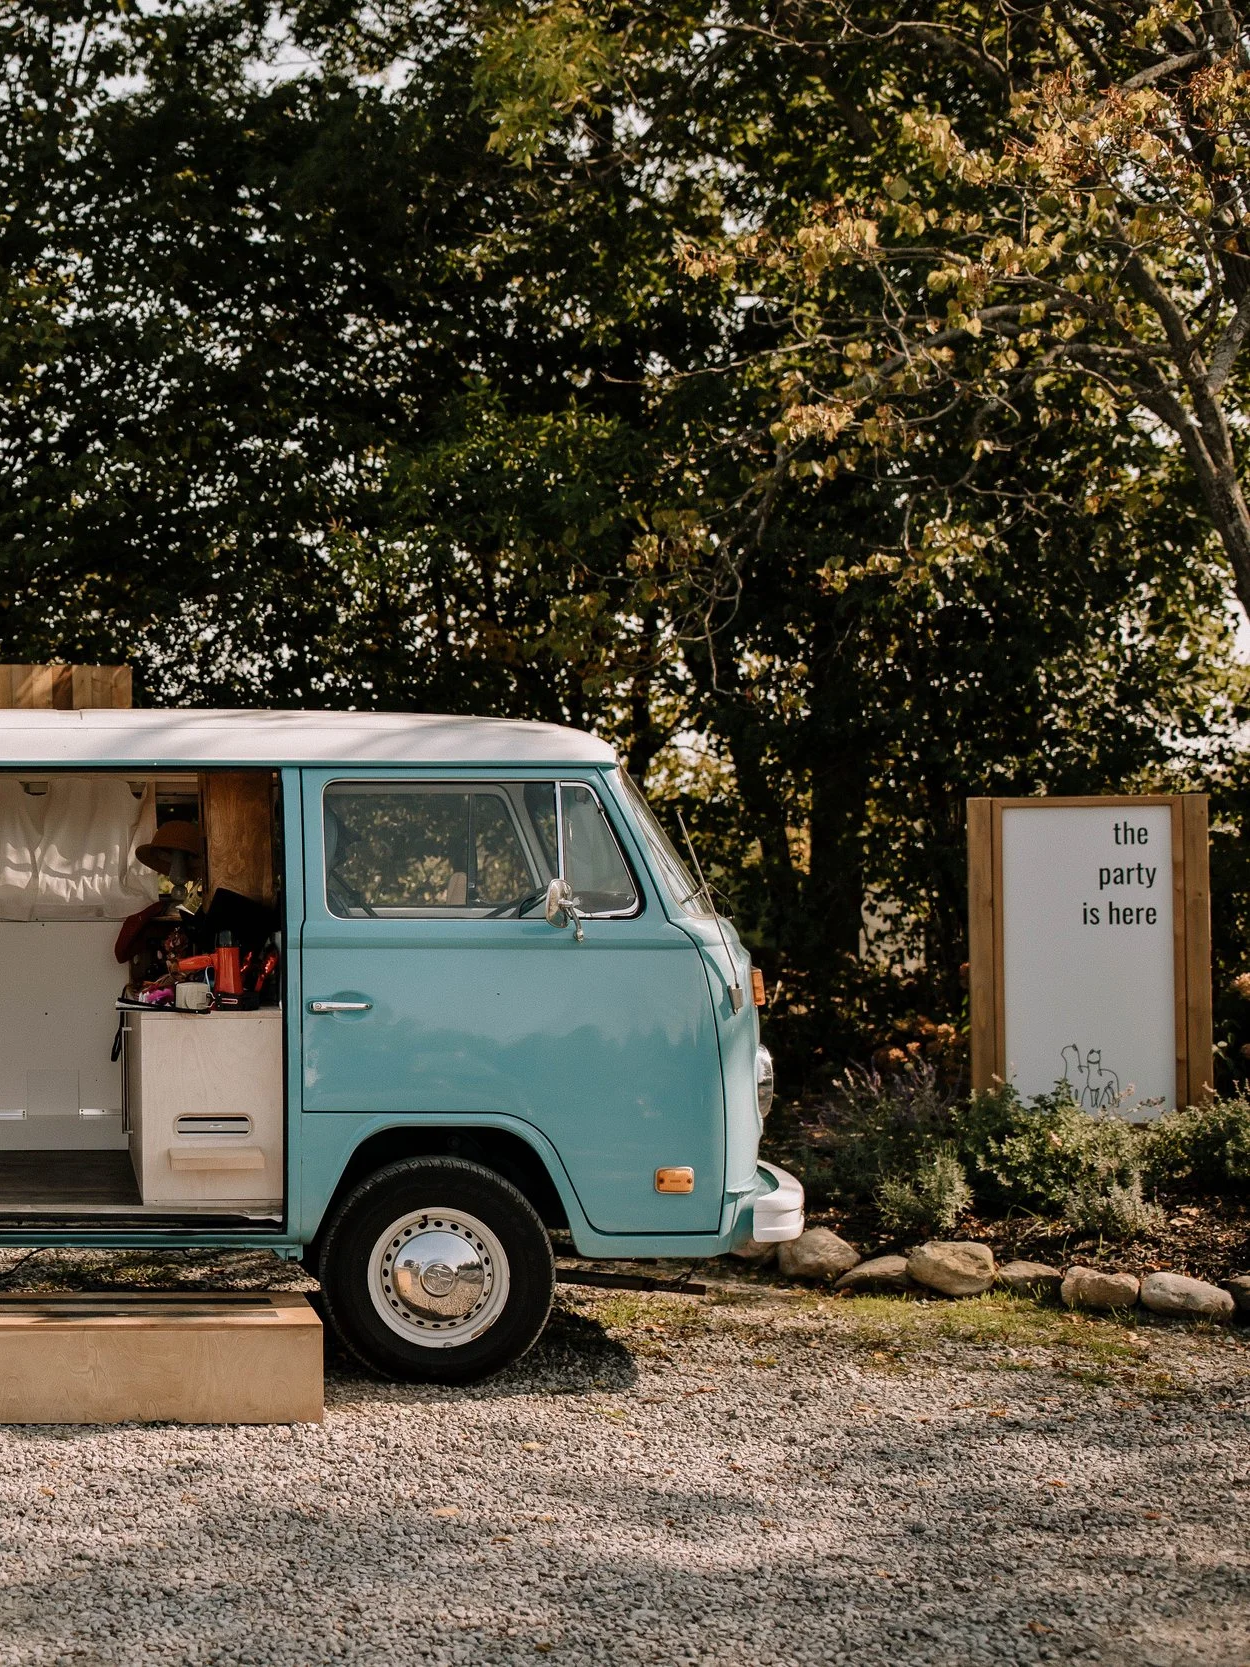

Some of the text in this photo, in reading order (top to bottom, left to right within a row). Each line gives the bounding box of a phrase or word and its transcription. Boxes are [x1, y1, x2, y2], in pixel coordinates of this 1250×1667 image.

[1113, 821, 1149, 845] the
[1098, 862, 1158, 890] party
[1082, 901, 1157, 925] is here
